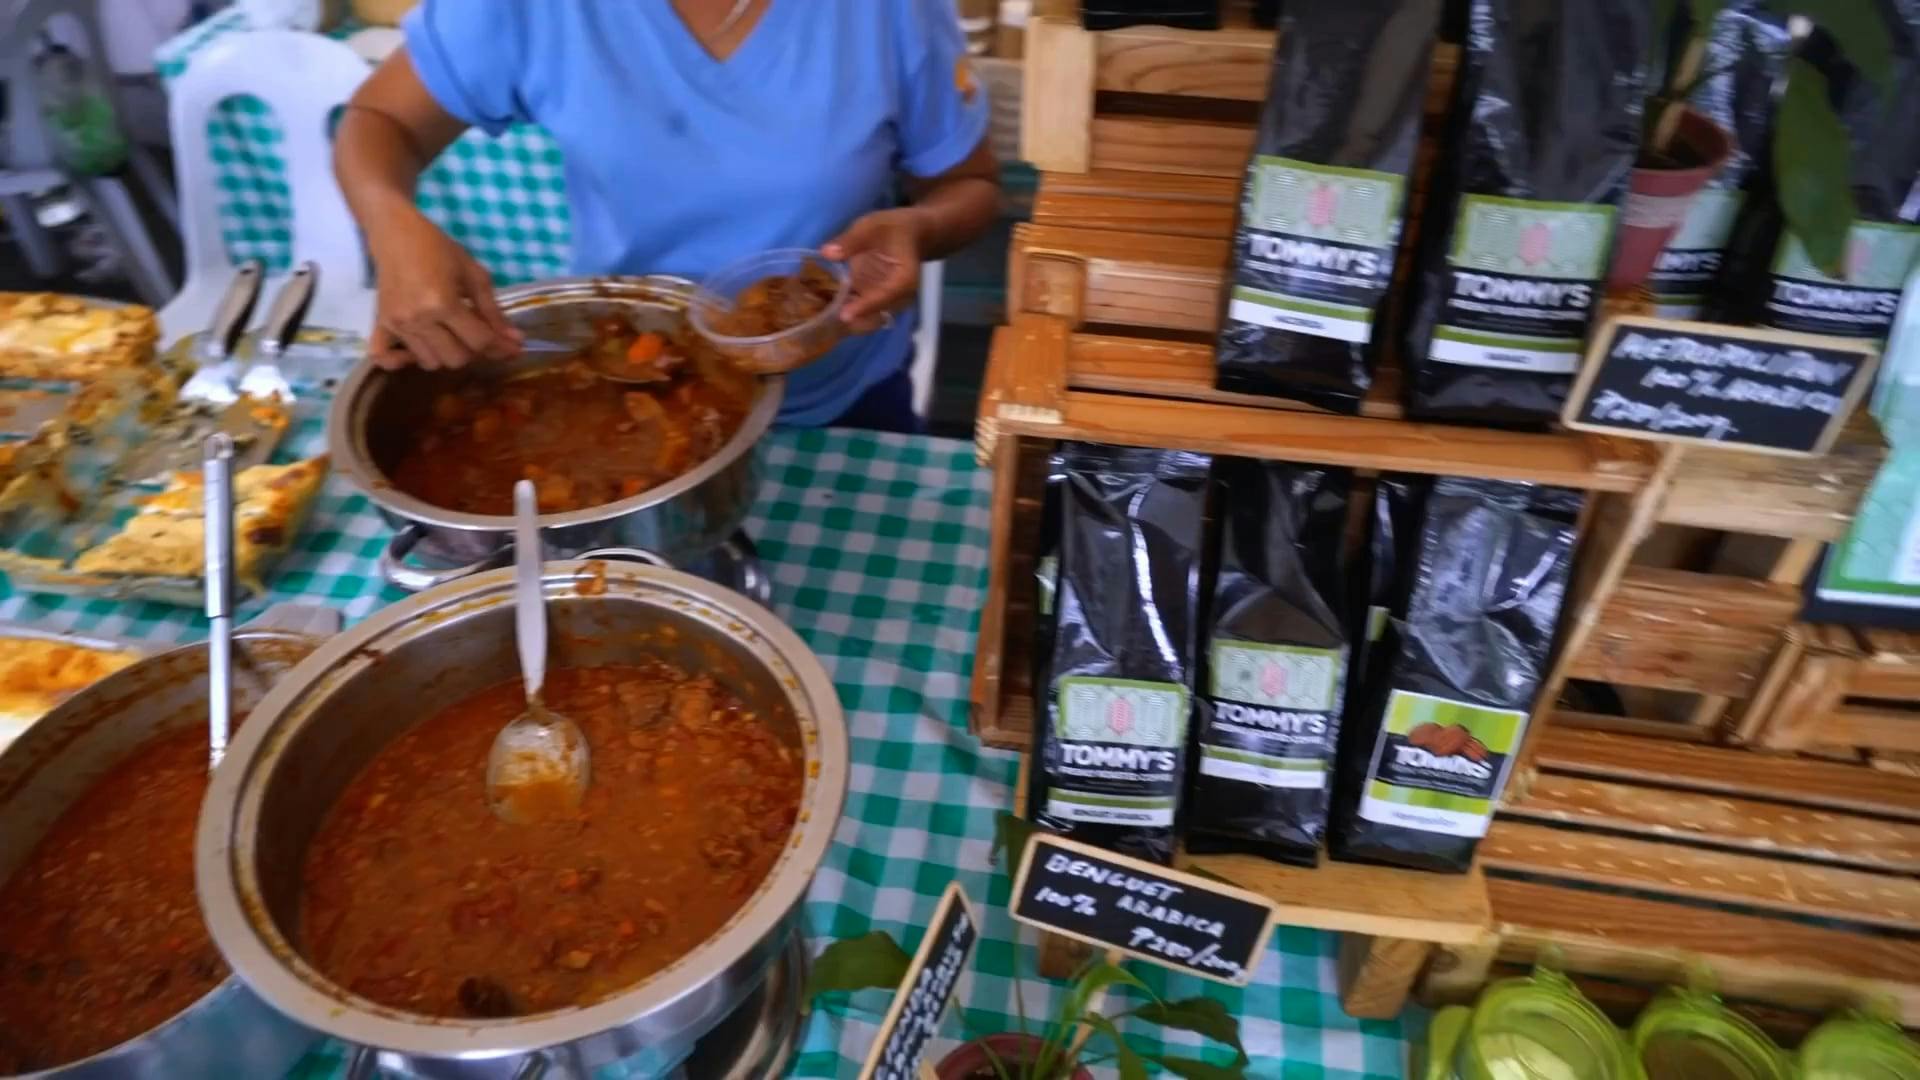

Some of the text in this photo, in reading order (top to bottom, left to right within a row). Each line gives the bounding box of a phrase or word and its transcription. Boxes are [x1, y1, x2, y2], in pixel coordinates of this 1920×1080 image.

[1213, 700, 1328, 735] TOMMY'S
[1060, 743, 1176, 772] TOMMY'S
[1044, 853, 1184, 902] BENGUET
[1034, 886, 1226, 938] 100% ARABICA
